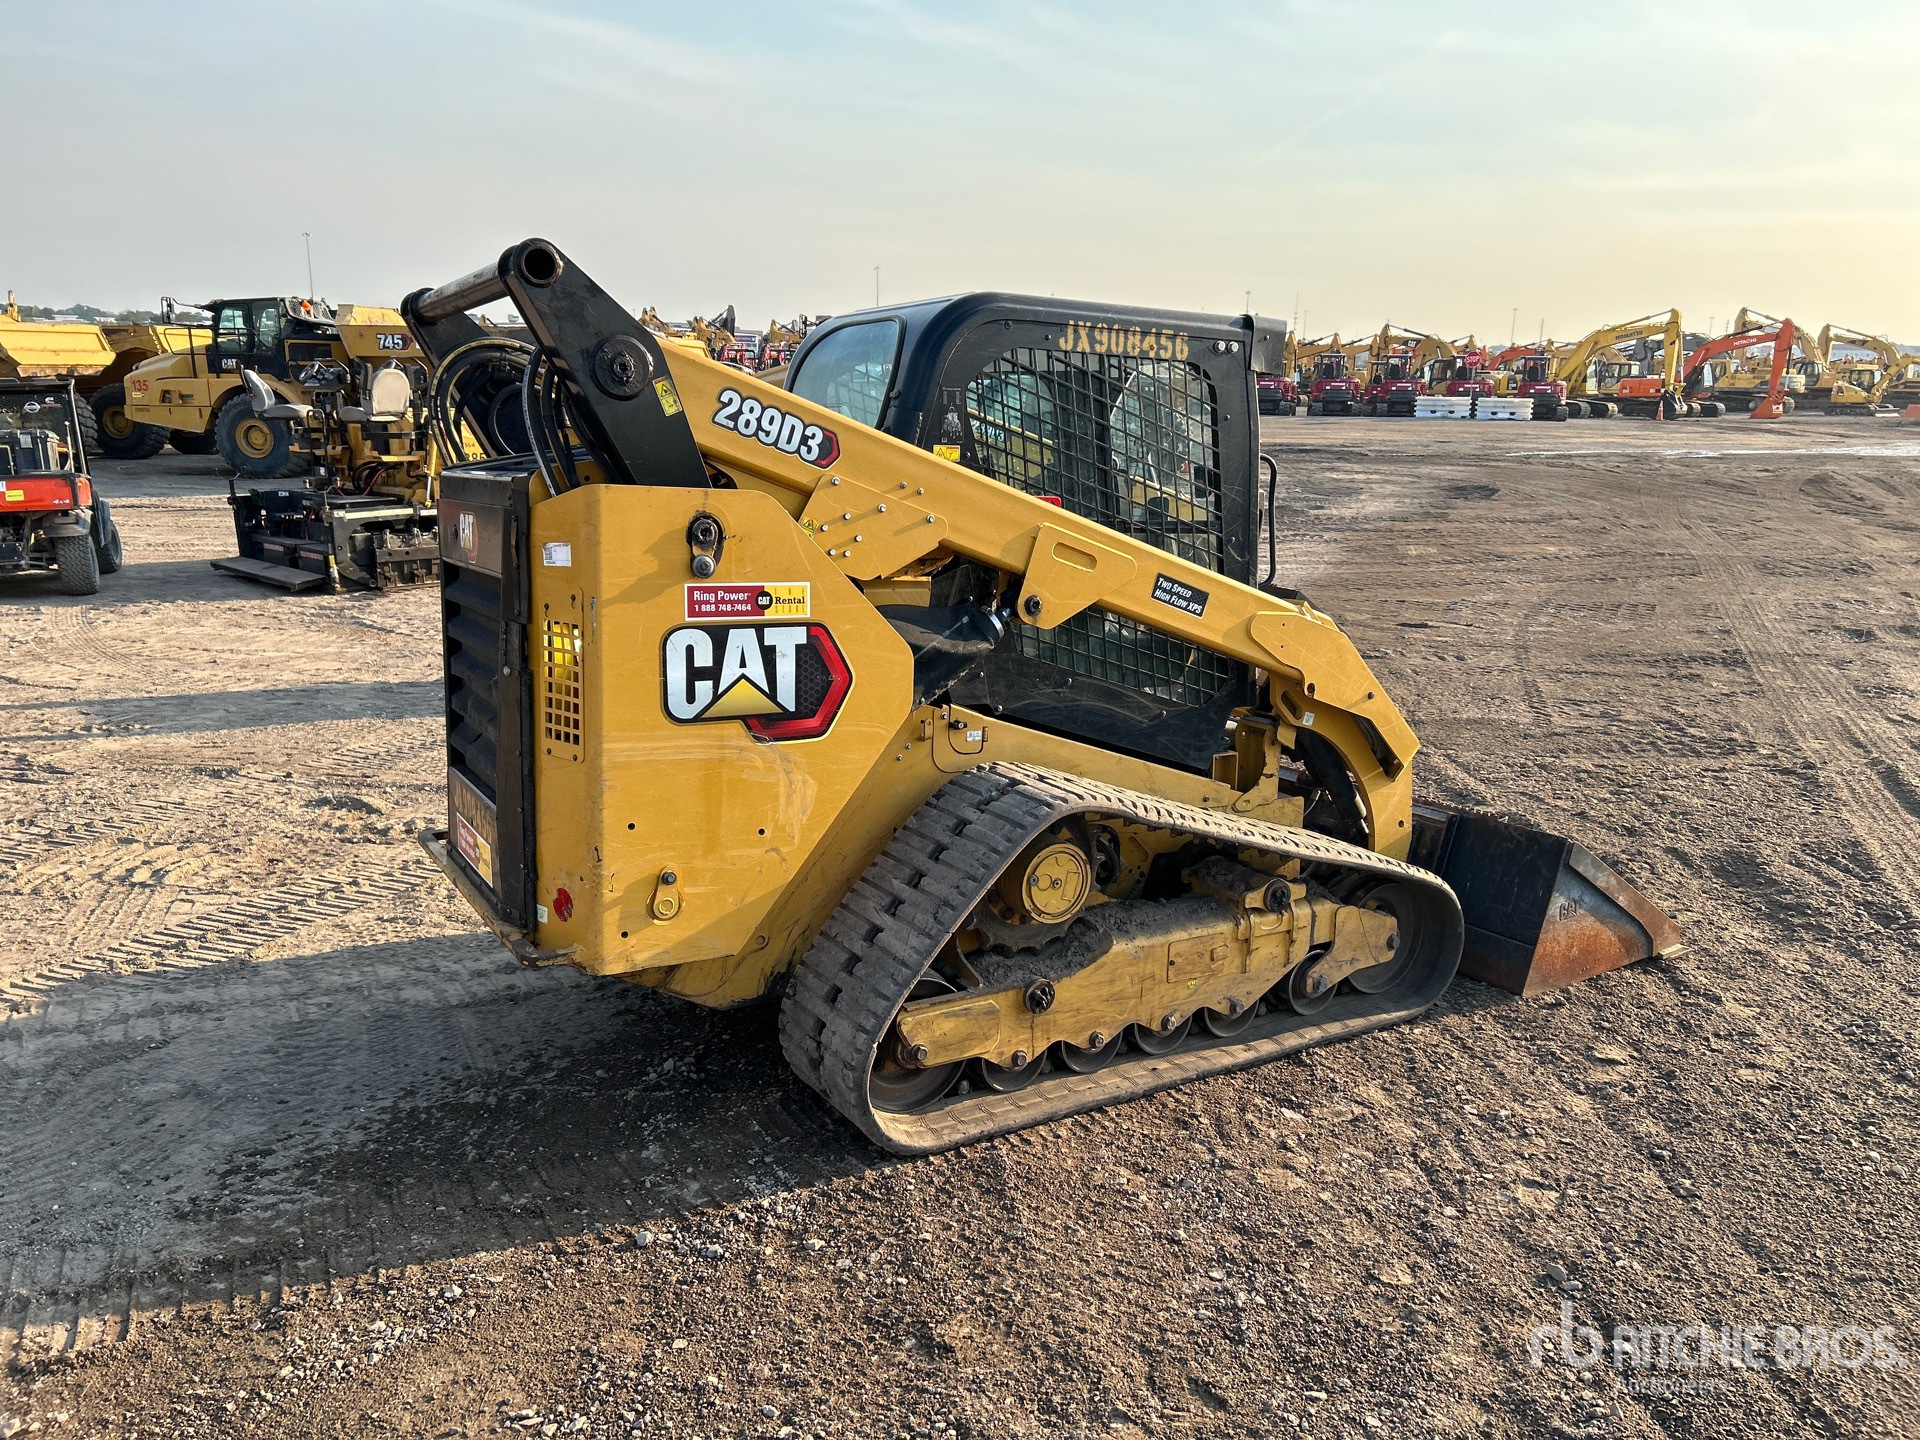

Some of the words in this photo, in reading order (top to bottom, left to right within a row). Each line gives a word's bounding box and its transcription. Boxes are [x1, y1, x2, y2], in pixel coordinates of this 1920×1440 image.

[1059, 320, 1189, 361] JX908456
[1615, 330, 1644, 340] KOMATSU
[376, 334, 403, 350] 745
[1733, 338, 1757, 346] HITACHI
[221, 359, 237, 369] CAT
[1466, 355, 1480, 363] STOP
[132, 380, 149, 391] 135
[714, 390, 824, 461] 289D3
[460, 513, 474, 550] CAT
[693, 590, 715, 603] Ring
[717, 590, 749, 601] Power
[757, 596, 771, 605] CAT
[774, 596, 806, 605] Rental
[694, 604, 699, 612] 1
[700, 604, 716, 612] 888
[717, 603, 752, 612] 748-7464
[1187, 601, 1203, 614] XPS
[666, 626, 807, 720] CAT
